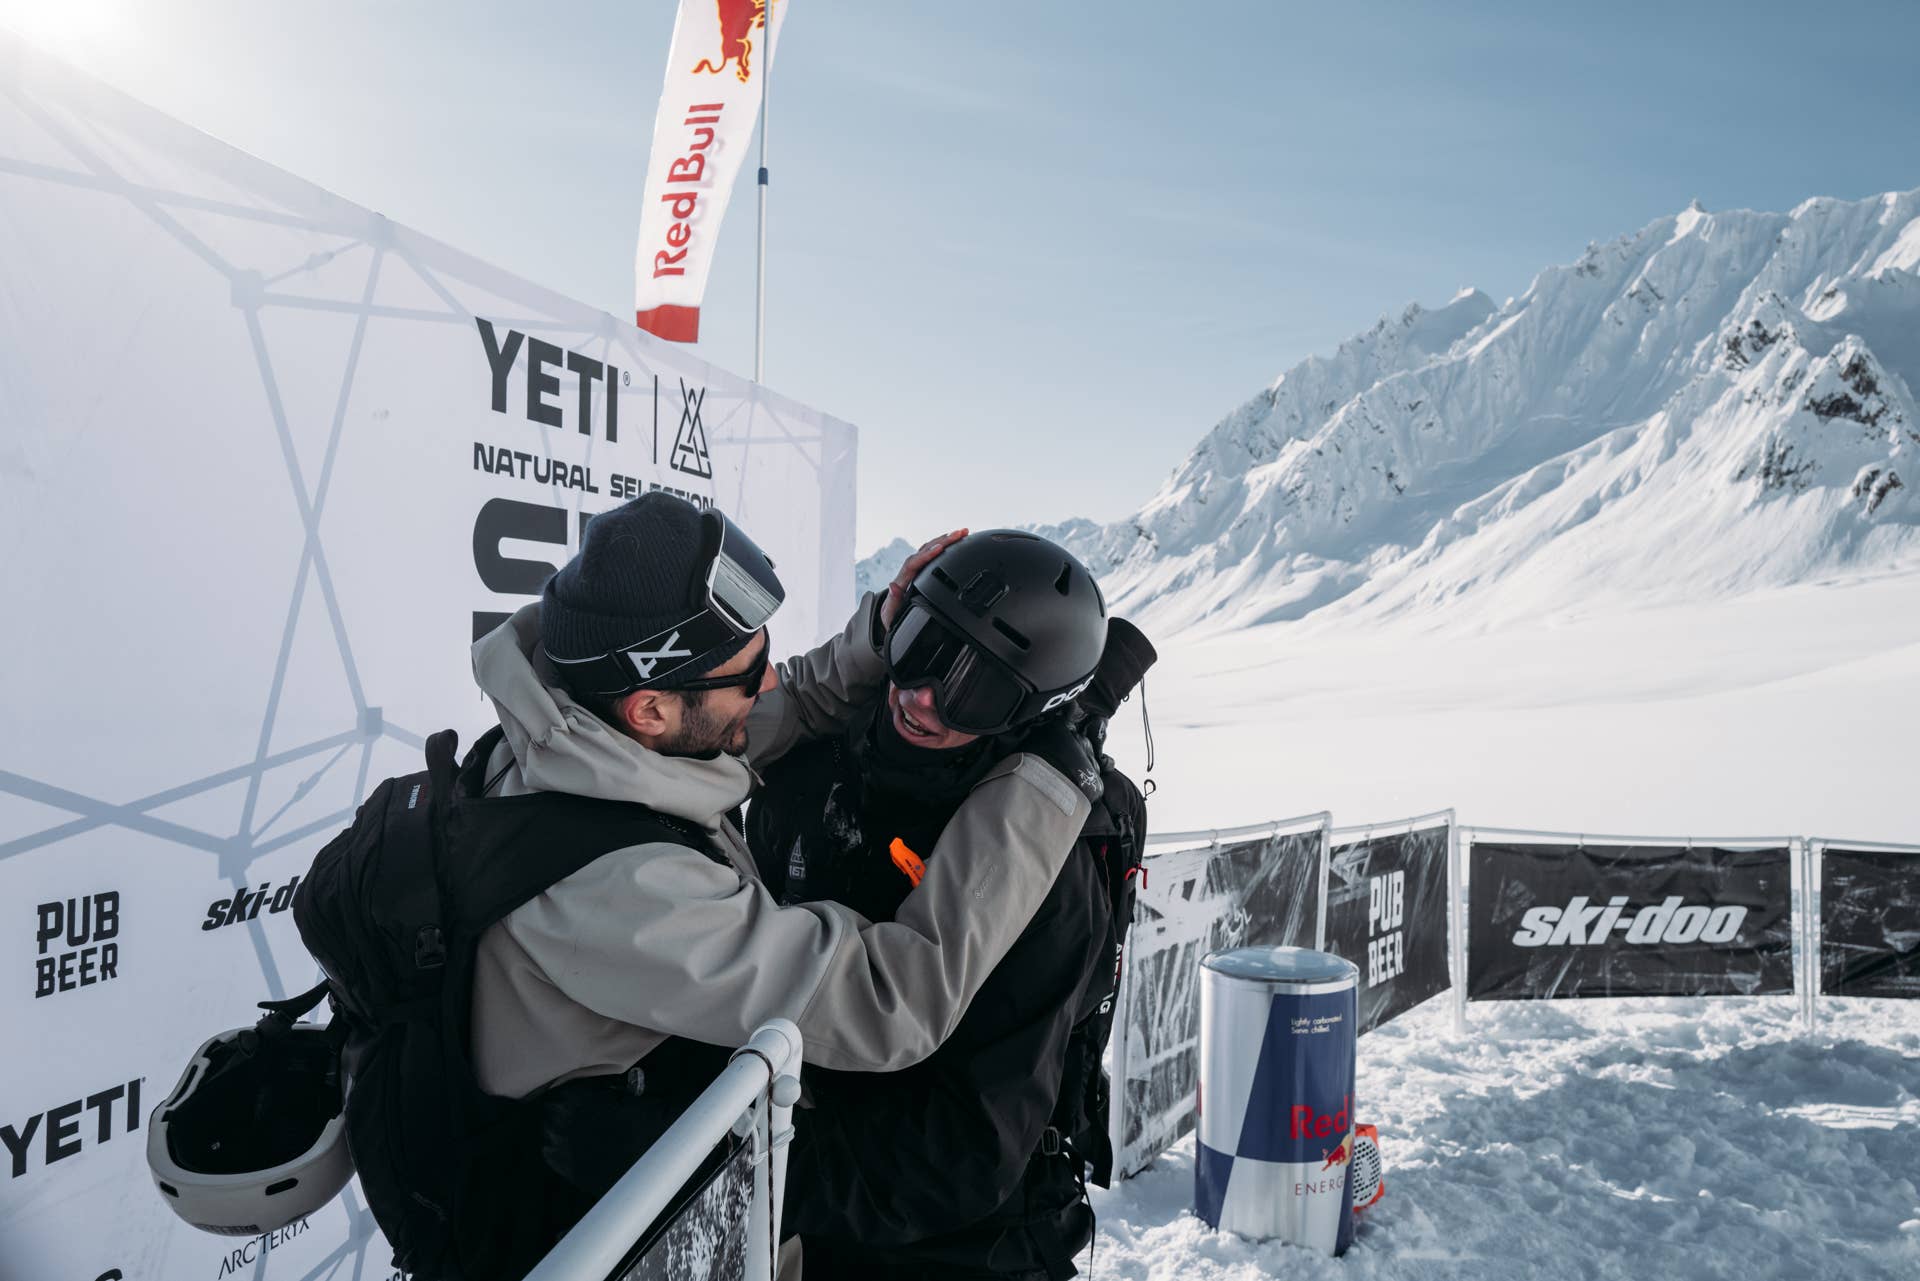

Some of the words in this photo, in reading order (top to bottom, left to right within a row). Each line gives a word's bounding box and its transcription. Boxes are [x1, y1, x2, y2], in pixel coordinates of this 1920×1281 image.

[667, 102, 725, 183] Bull
[653, 191, 698, 279] Red
[475, 316, 618, 443] YETI
[474, 441, 599, 494] NATURAL
[36, 891, 120, 954] PUB
[201, 875, 300, 931] ski-d
[1369, 870, 1405, 937] PUB
[1512, 896, 1748, 947] ski-doo
[35, 943, 118, 999] BEER
[1368, 930, 1404, 989] BEER
[0, 1078, 141, 1179] YETI
[1290, 1094, 1349, 1140] Red
